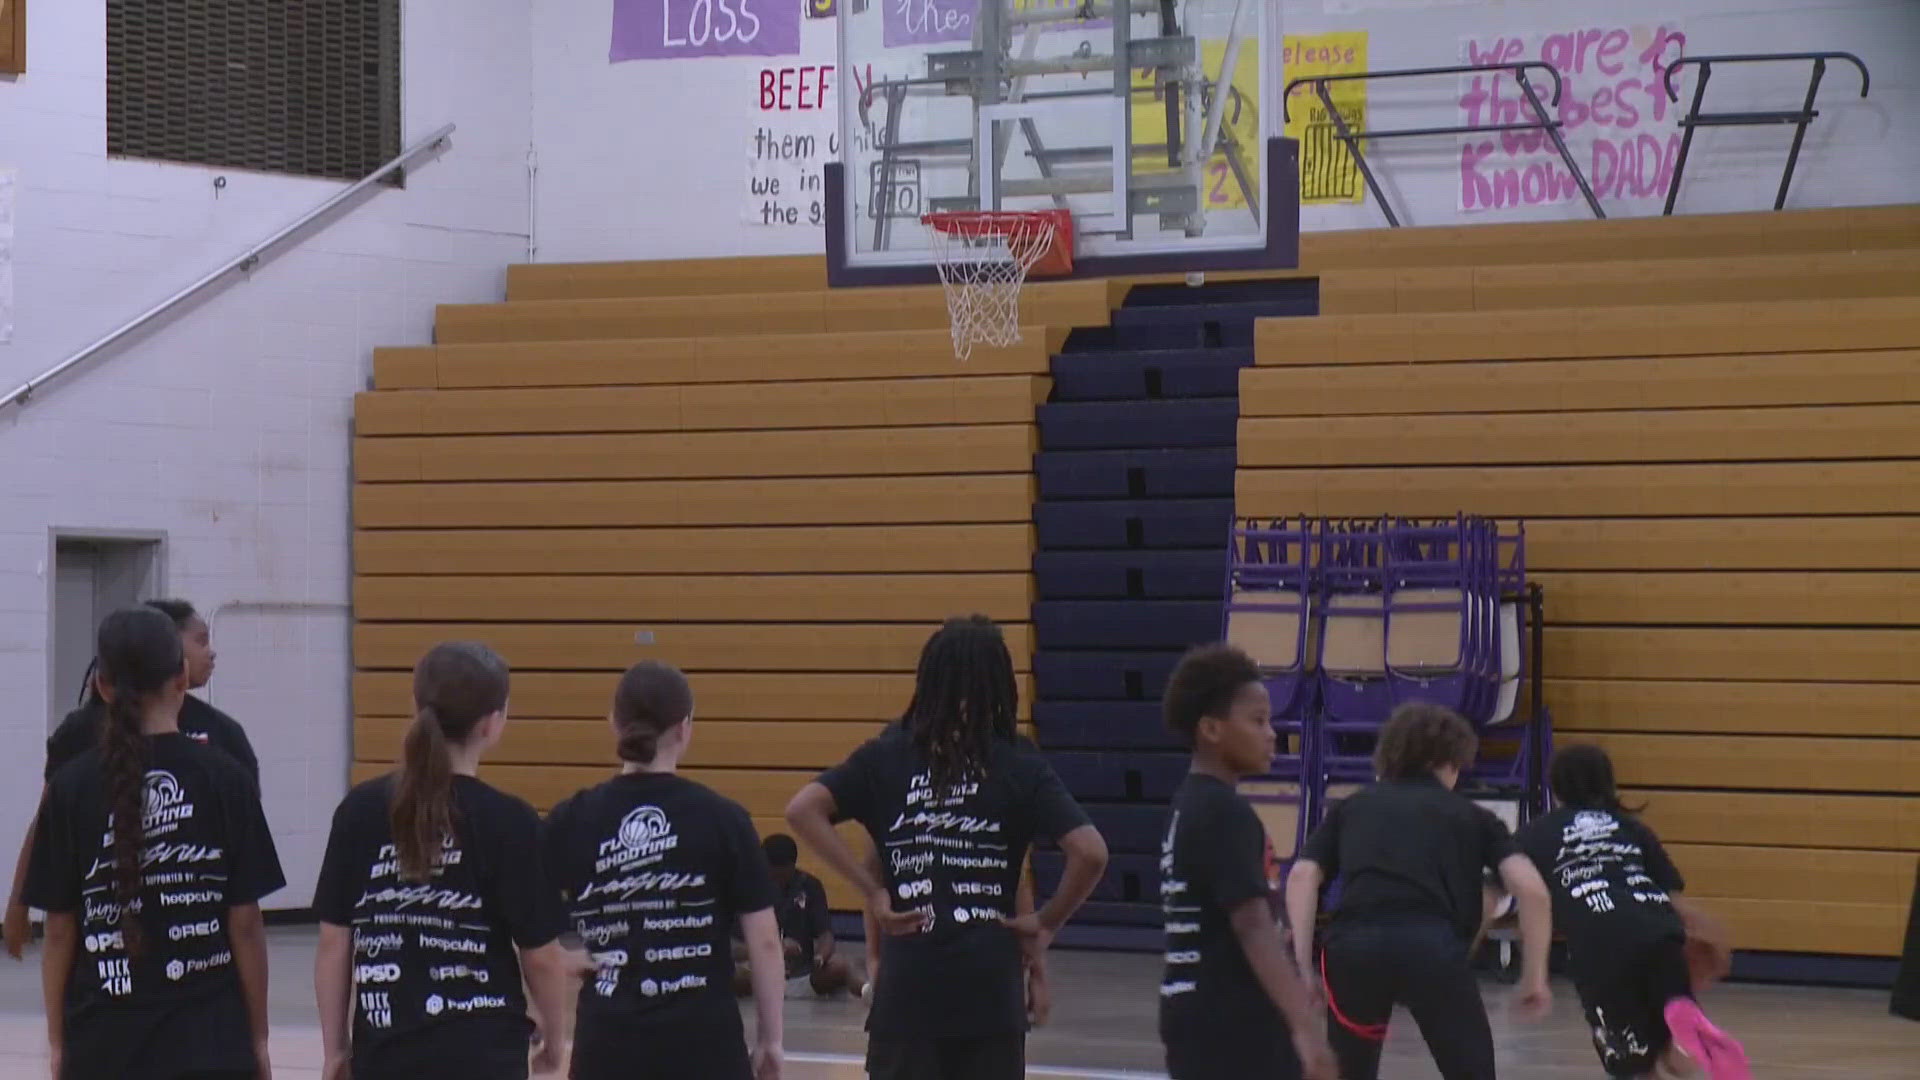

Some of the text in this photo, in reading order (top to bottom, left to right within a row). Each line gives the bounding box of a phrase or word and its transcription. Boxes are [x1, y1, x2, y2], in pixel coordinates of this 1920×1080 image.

[1541, 28, 1630, 76] are
[759, 65, 835, 110] BEEF
[754, 127, 816, 160] them
[751, 175, 780, 196] we
[760, 200, 799, 226] the
